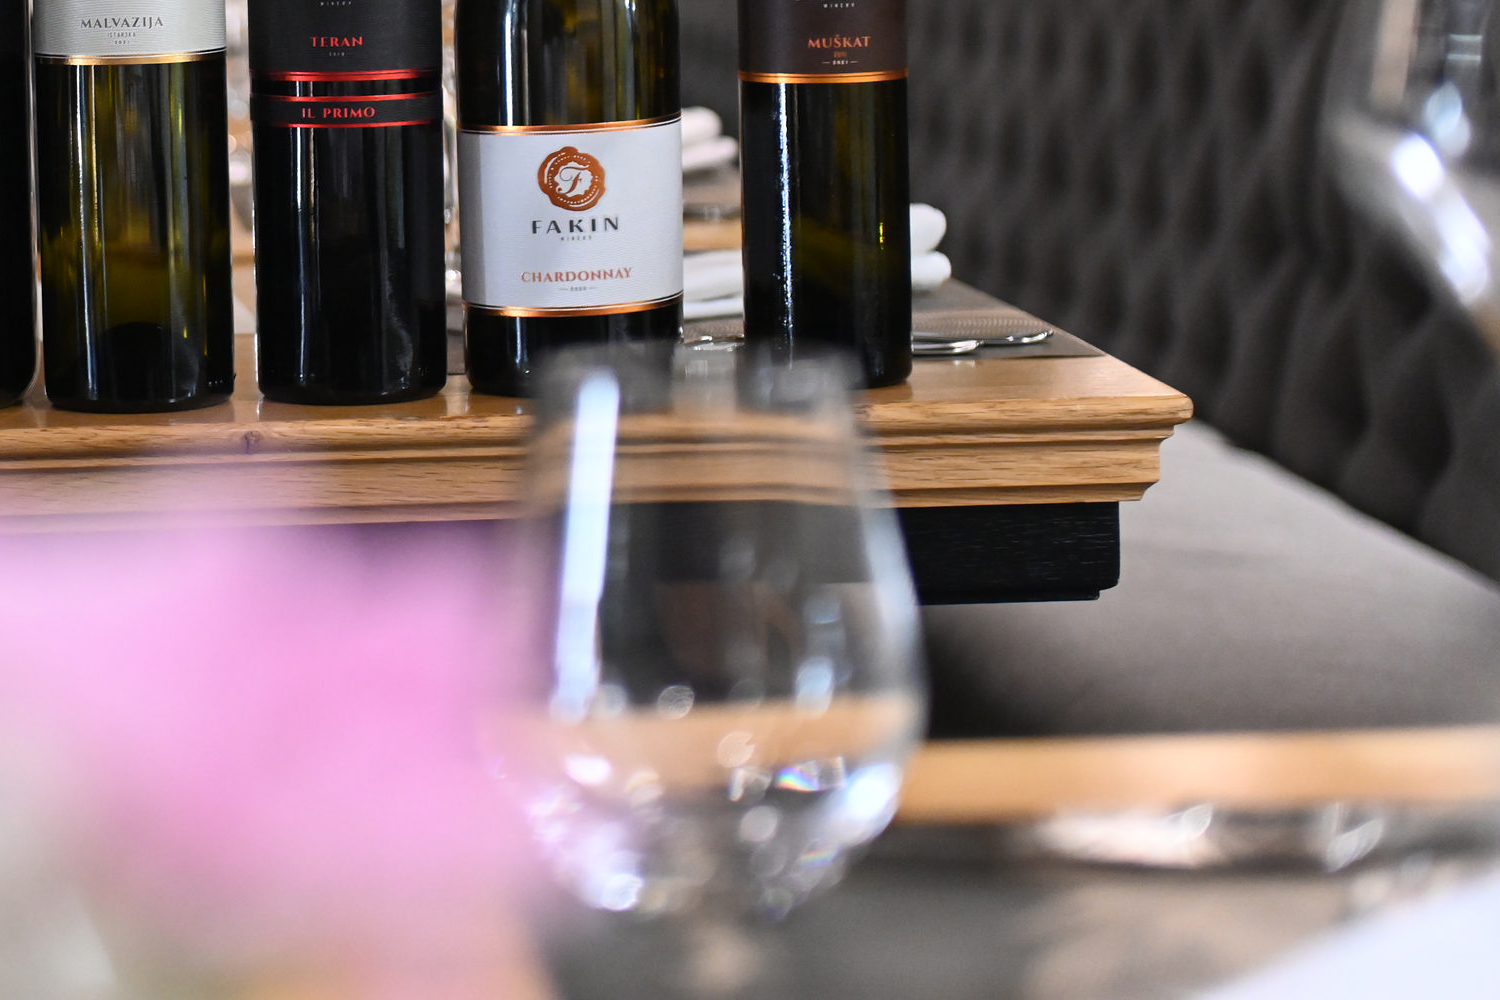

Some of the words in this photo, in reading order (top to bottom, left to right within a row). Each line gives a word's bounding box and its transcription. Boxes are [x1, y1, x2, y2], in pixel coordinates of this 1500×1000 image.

[80, 17, 164, 30] MALVAZIJA
[310, 36, 363, 47] TERAN
[808, 34, 872, 48] MUŠKAT
[302, 108, 316, 118] IL
[323, 107, 376, 118] PRIMO
[532, 217, 619, 234] FAKIN
[521, 267, 632, 283] CHARDONNAY
